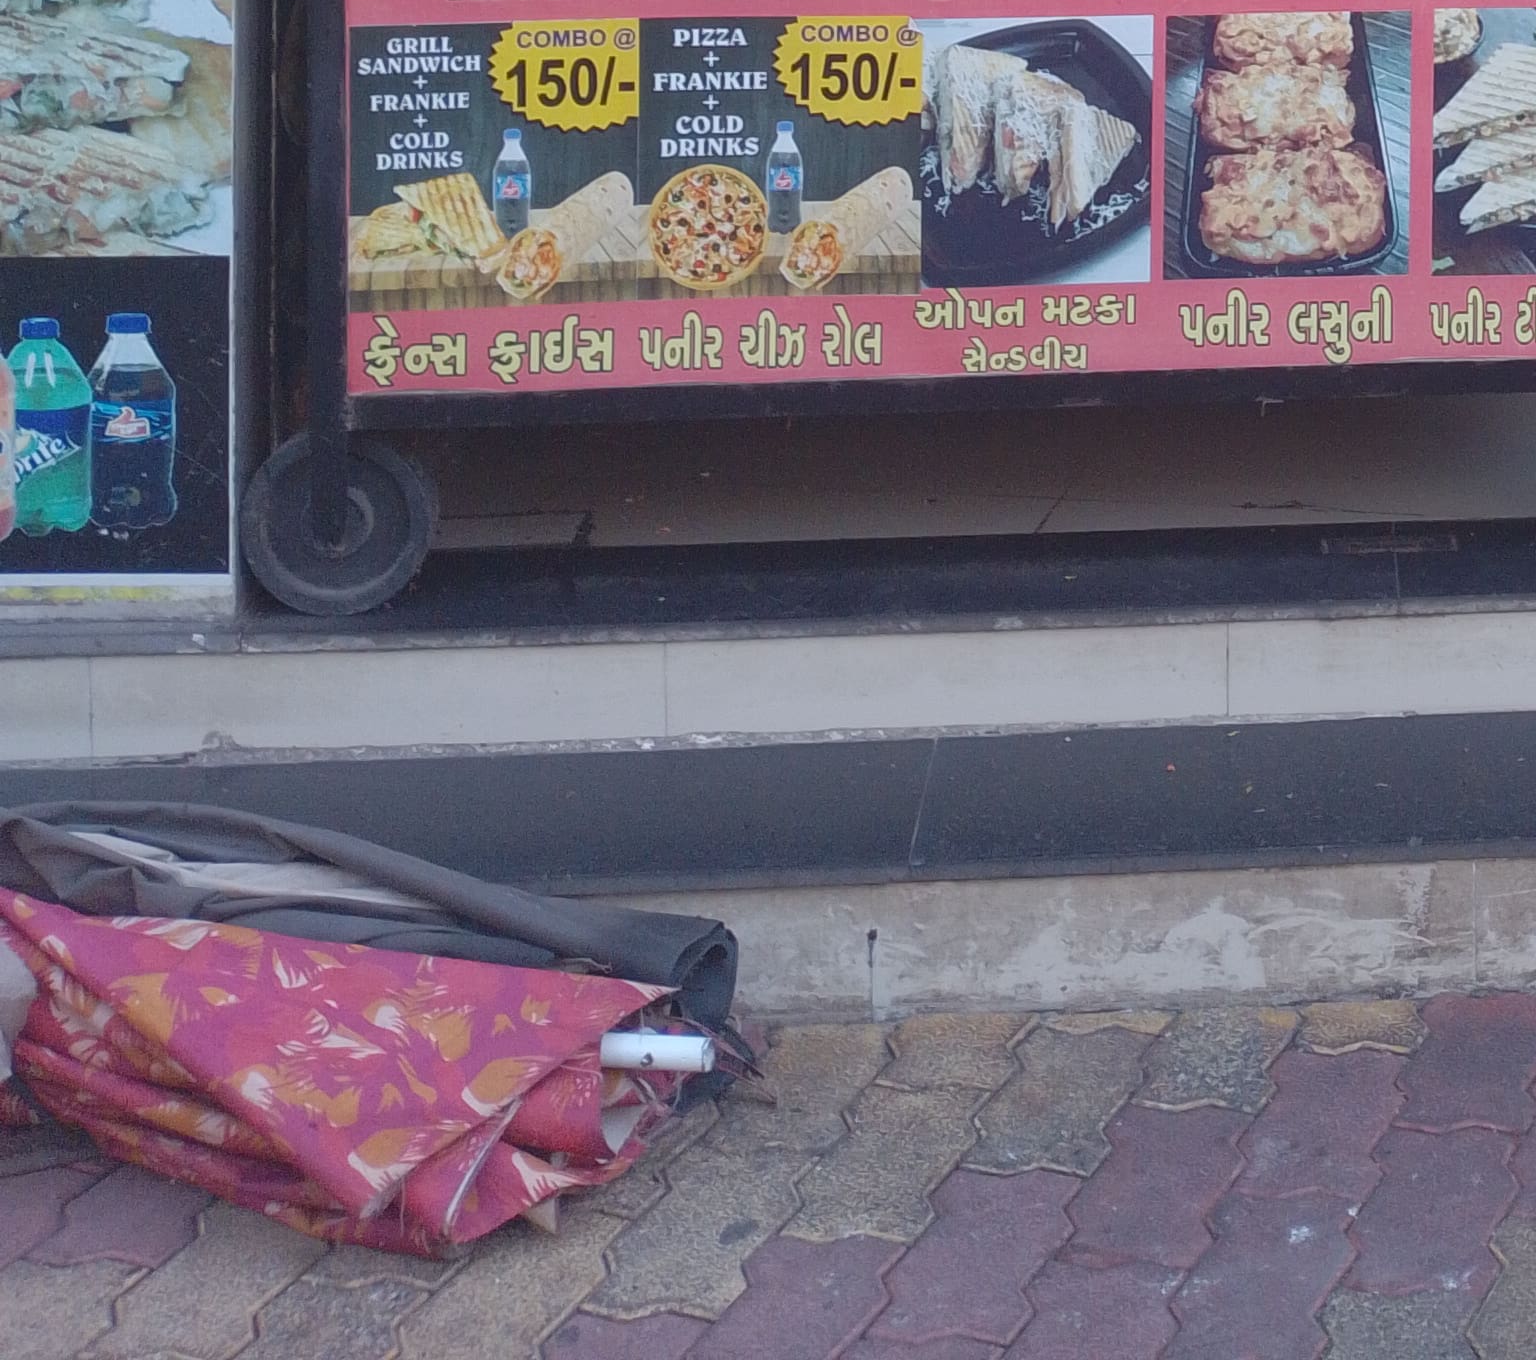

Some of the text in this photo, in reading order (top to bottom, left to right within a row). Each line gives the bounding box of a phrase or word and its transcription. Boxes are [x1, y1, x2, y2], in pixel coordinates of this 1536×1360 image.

[516, 28, 636, 50] COMBO @
[673, 28, 748, 47] PIZZA
[801, 24, 919, 45] COMBO @
[387, 36, 453, 55] GRILL
[357, 54, 481, 75] SANDWICH
[506, 56, 635, 108] 150/-
[653, 71, 768, 92] FRANKIE
[791, 52, 916, 101] 150/-
[370, 92, 470, 111] FRANKIE
[675, 116, 744, 134] COLD
[390, 132, 450, 150] COLD
[659, 136, 760, 158] DRINKS
[376, 151, 464, 171] DRINKS
[914, 288, 1137, 329] ઓપન મટકા
[1429, 286, 1502, 344] પનીર
[1180, 286, 1393, 365] પનીર લસુની
[639, 303, 882, 370] પનીર ચીઝ રોલ
[961, 335, 1088, 372] સેન્ડવીચ
